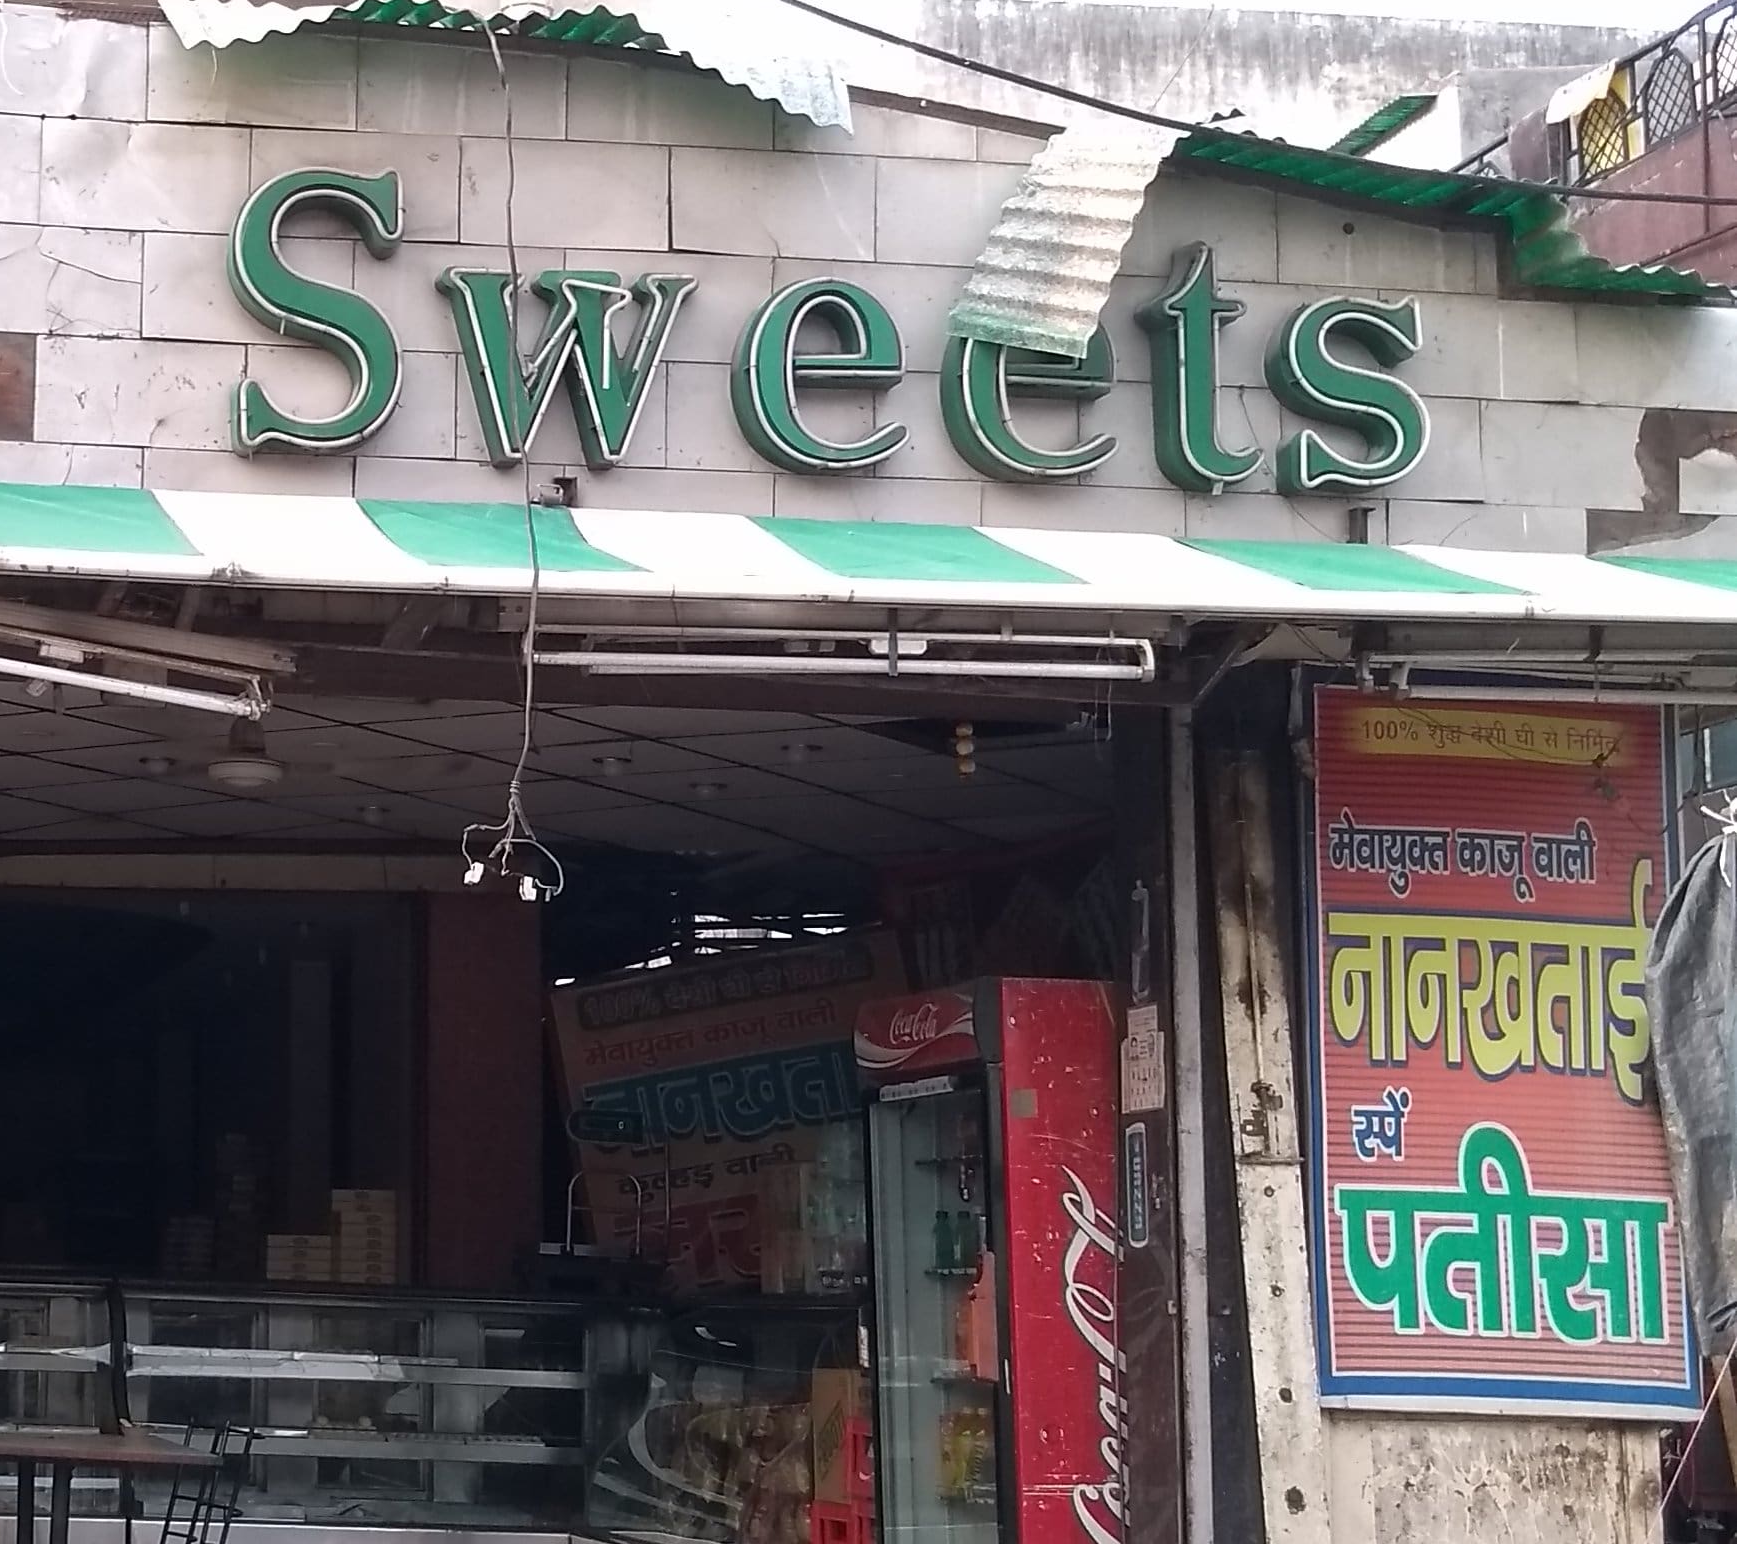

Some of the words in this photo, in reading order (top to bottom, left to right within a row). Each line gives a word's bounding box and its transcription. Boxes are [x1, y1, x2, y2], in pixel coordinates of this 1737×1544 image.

[228, 165, 1433, 496] Sweets
[1362, 719, 1419, 741] 100%
[1328, 806, 1452, 899] मेवायुक्त
[1455, 827, 1536, 903] काजू
[1531, 816, 1598, 885] वाली
[1326, 858, 1654, 1106] नानखताई
[1334, 1120, 1675, 1345] पतीसा
